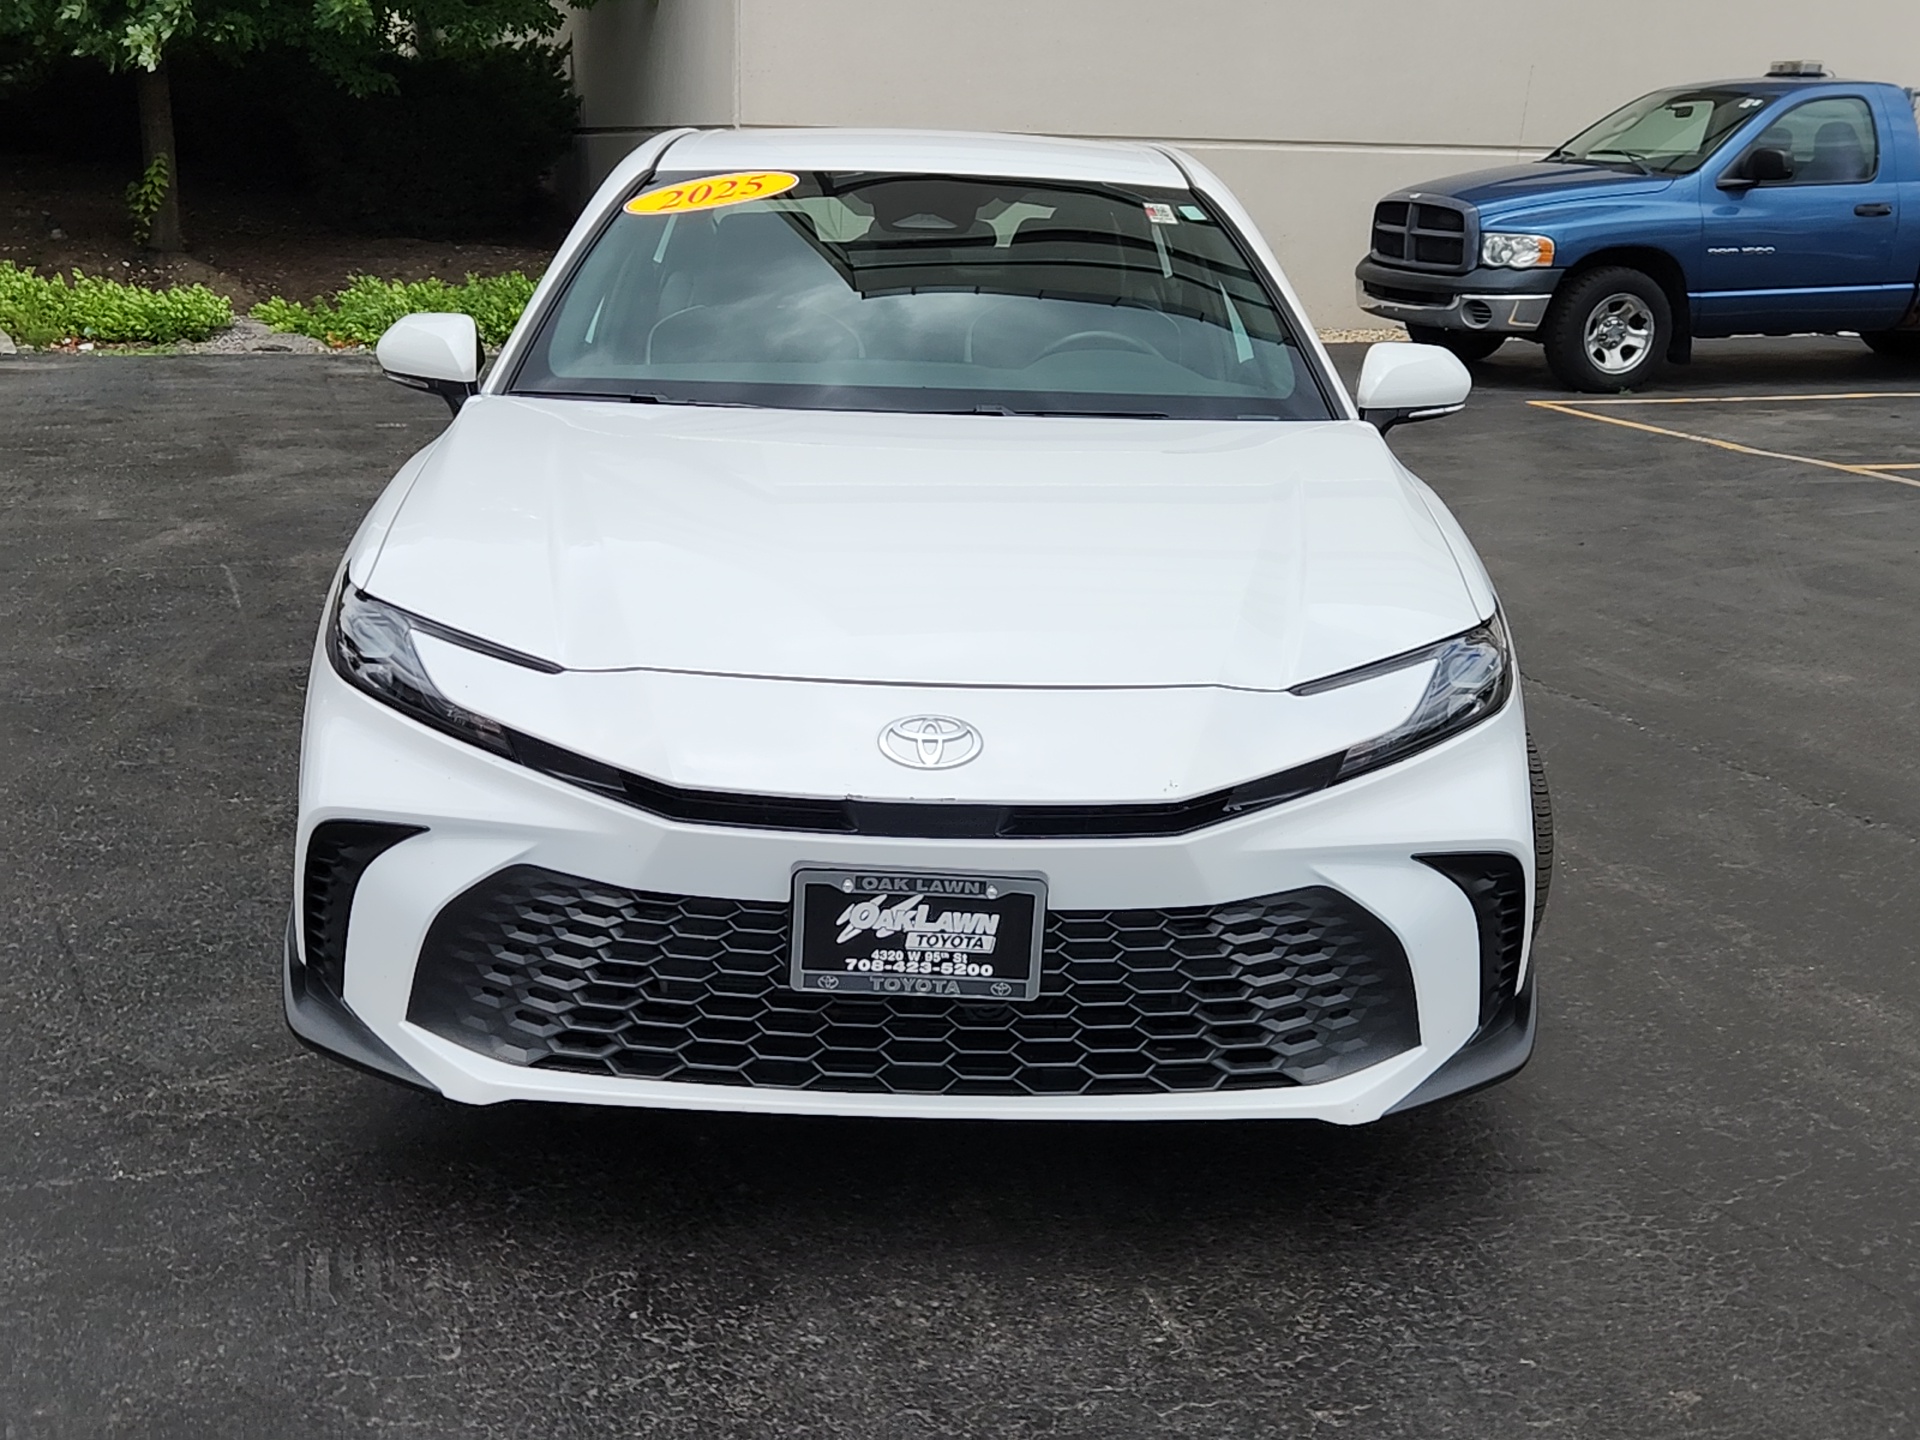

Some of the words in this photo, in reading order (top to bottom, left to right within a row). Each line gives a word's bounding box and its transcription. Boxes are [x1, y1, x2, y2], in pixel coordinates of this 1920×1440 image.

[656, 175, 767, 211] 2025
[862, 877, 909, 891] OAK
[916, 879, 980, 894] LAWN
[917, 934, 984, 949] TOYOTA
[871, 949, 905, 961] 4320
[908, 951, 921, 962] W
[924, 951, 950, 963] 95th
[952, 953, 968, 964] St
[845, 958, 994, 976] 708-423-5200
[869, 976, 961, 994] TOYOTA
